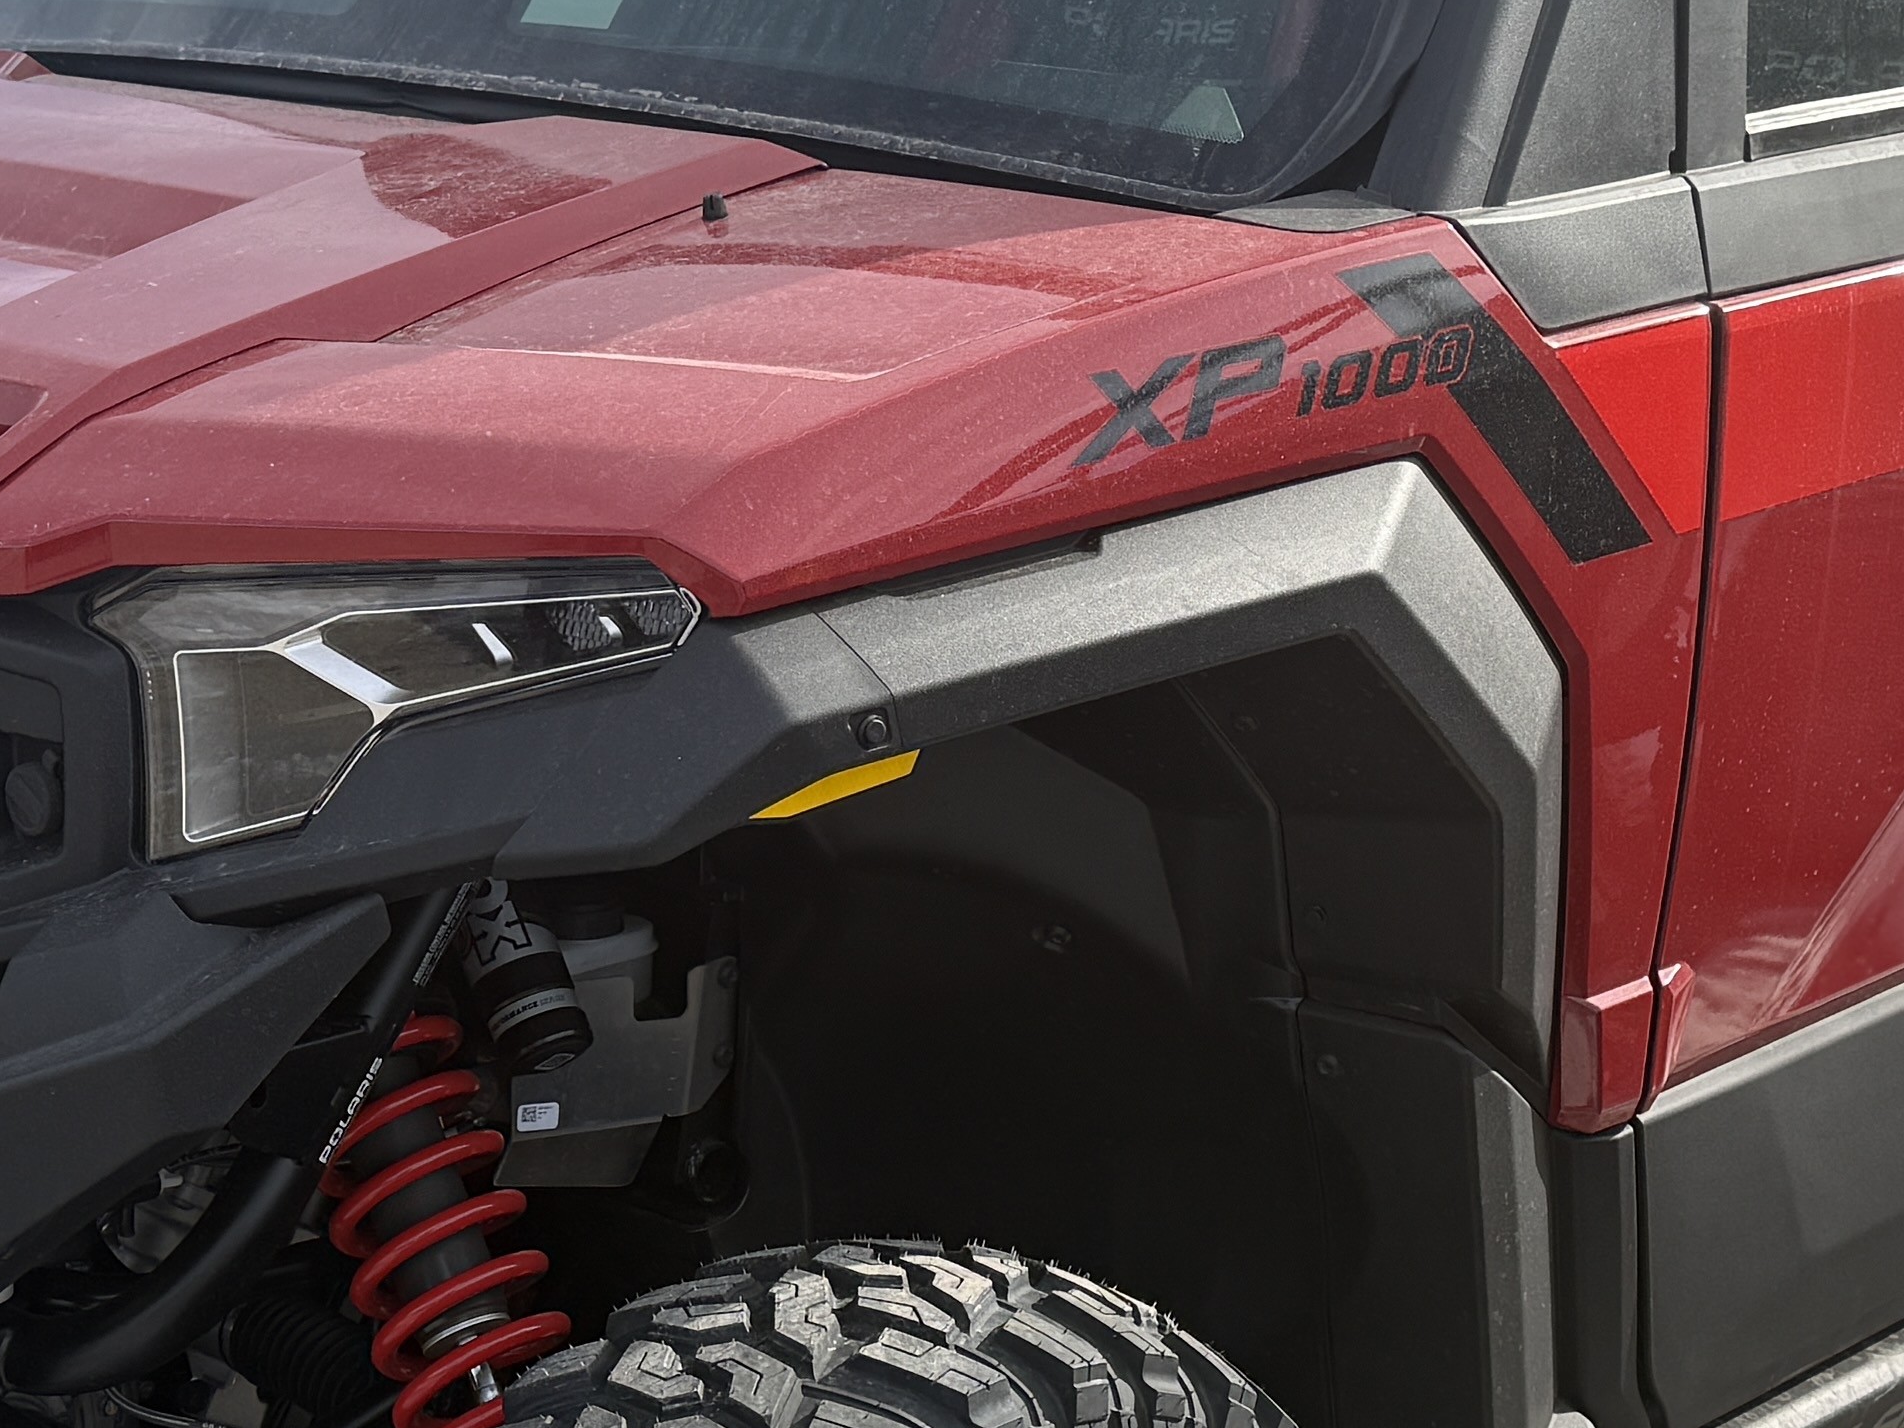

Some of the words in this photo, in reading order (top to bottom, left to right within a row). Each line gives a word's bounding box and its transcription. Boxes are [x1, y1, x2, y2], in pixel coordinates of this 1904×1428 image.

[1071, 334, 1285, 467] XP
[1296, 324, 1474, 418] 1000
[318, 1056, 383, 1165] POLARIS
